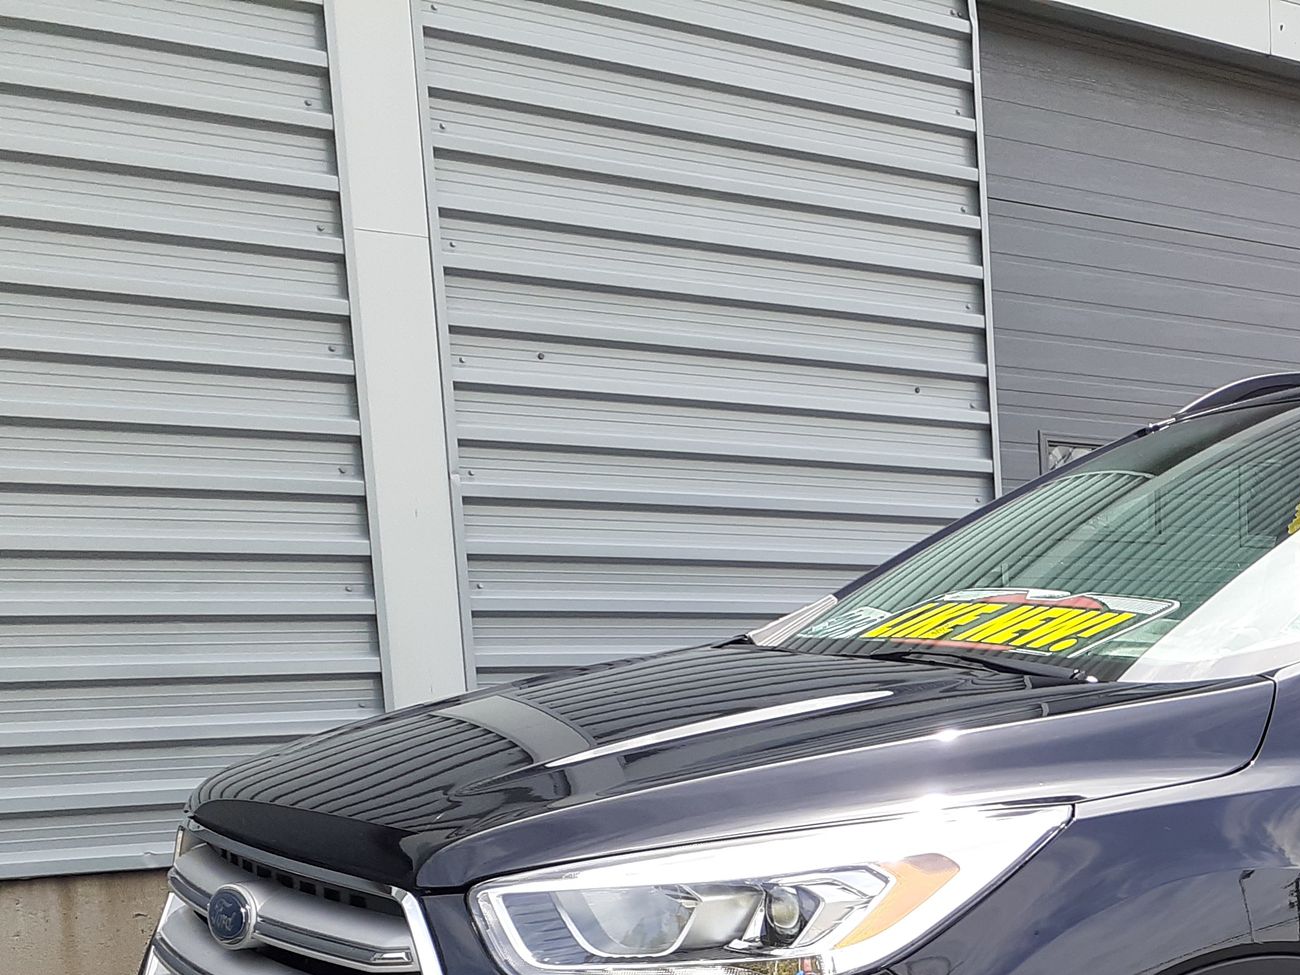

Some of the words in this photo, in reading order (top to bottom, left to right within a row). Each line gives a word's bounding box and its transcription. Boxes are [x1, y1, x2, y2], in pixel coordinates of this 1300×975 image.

[860, 602, 1008, 639] LIKE
[951, 605, 1136, 652] NEW!
[210, 897, 237, 932] Ford
